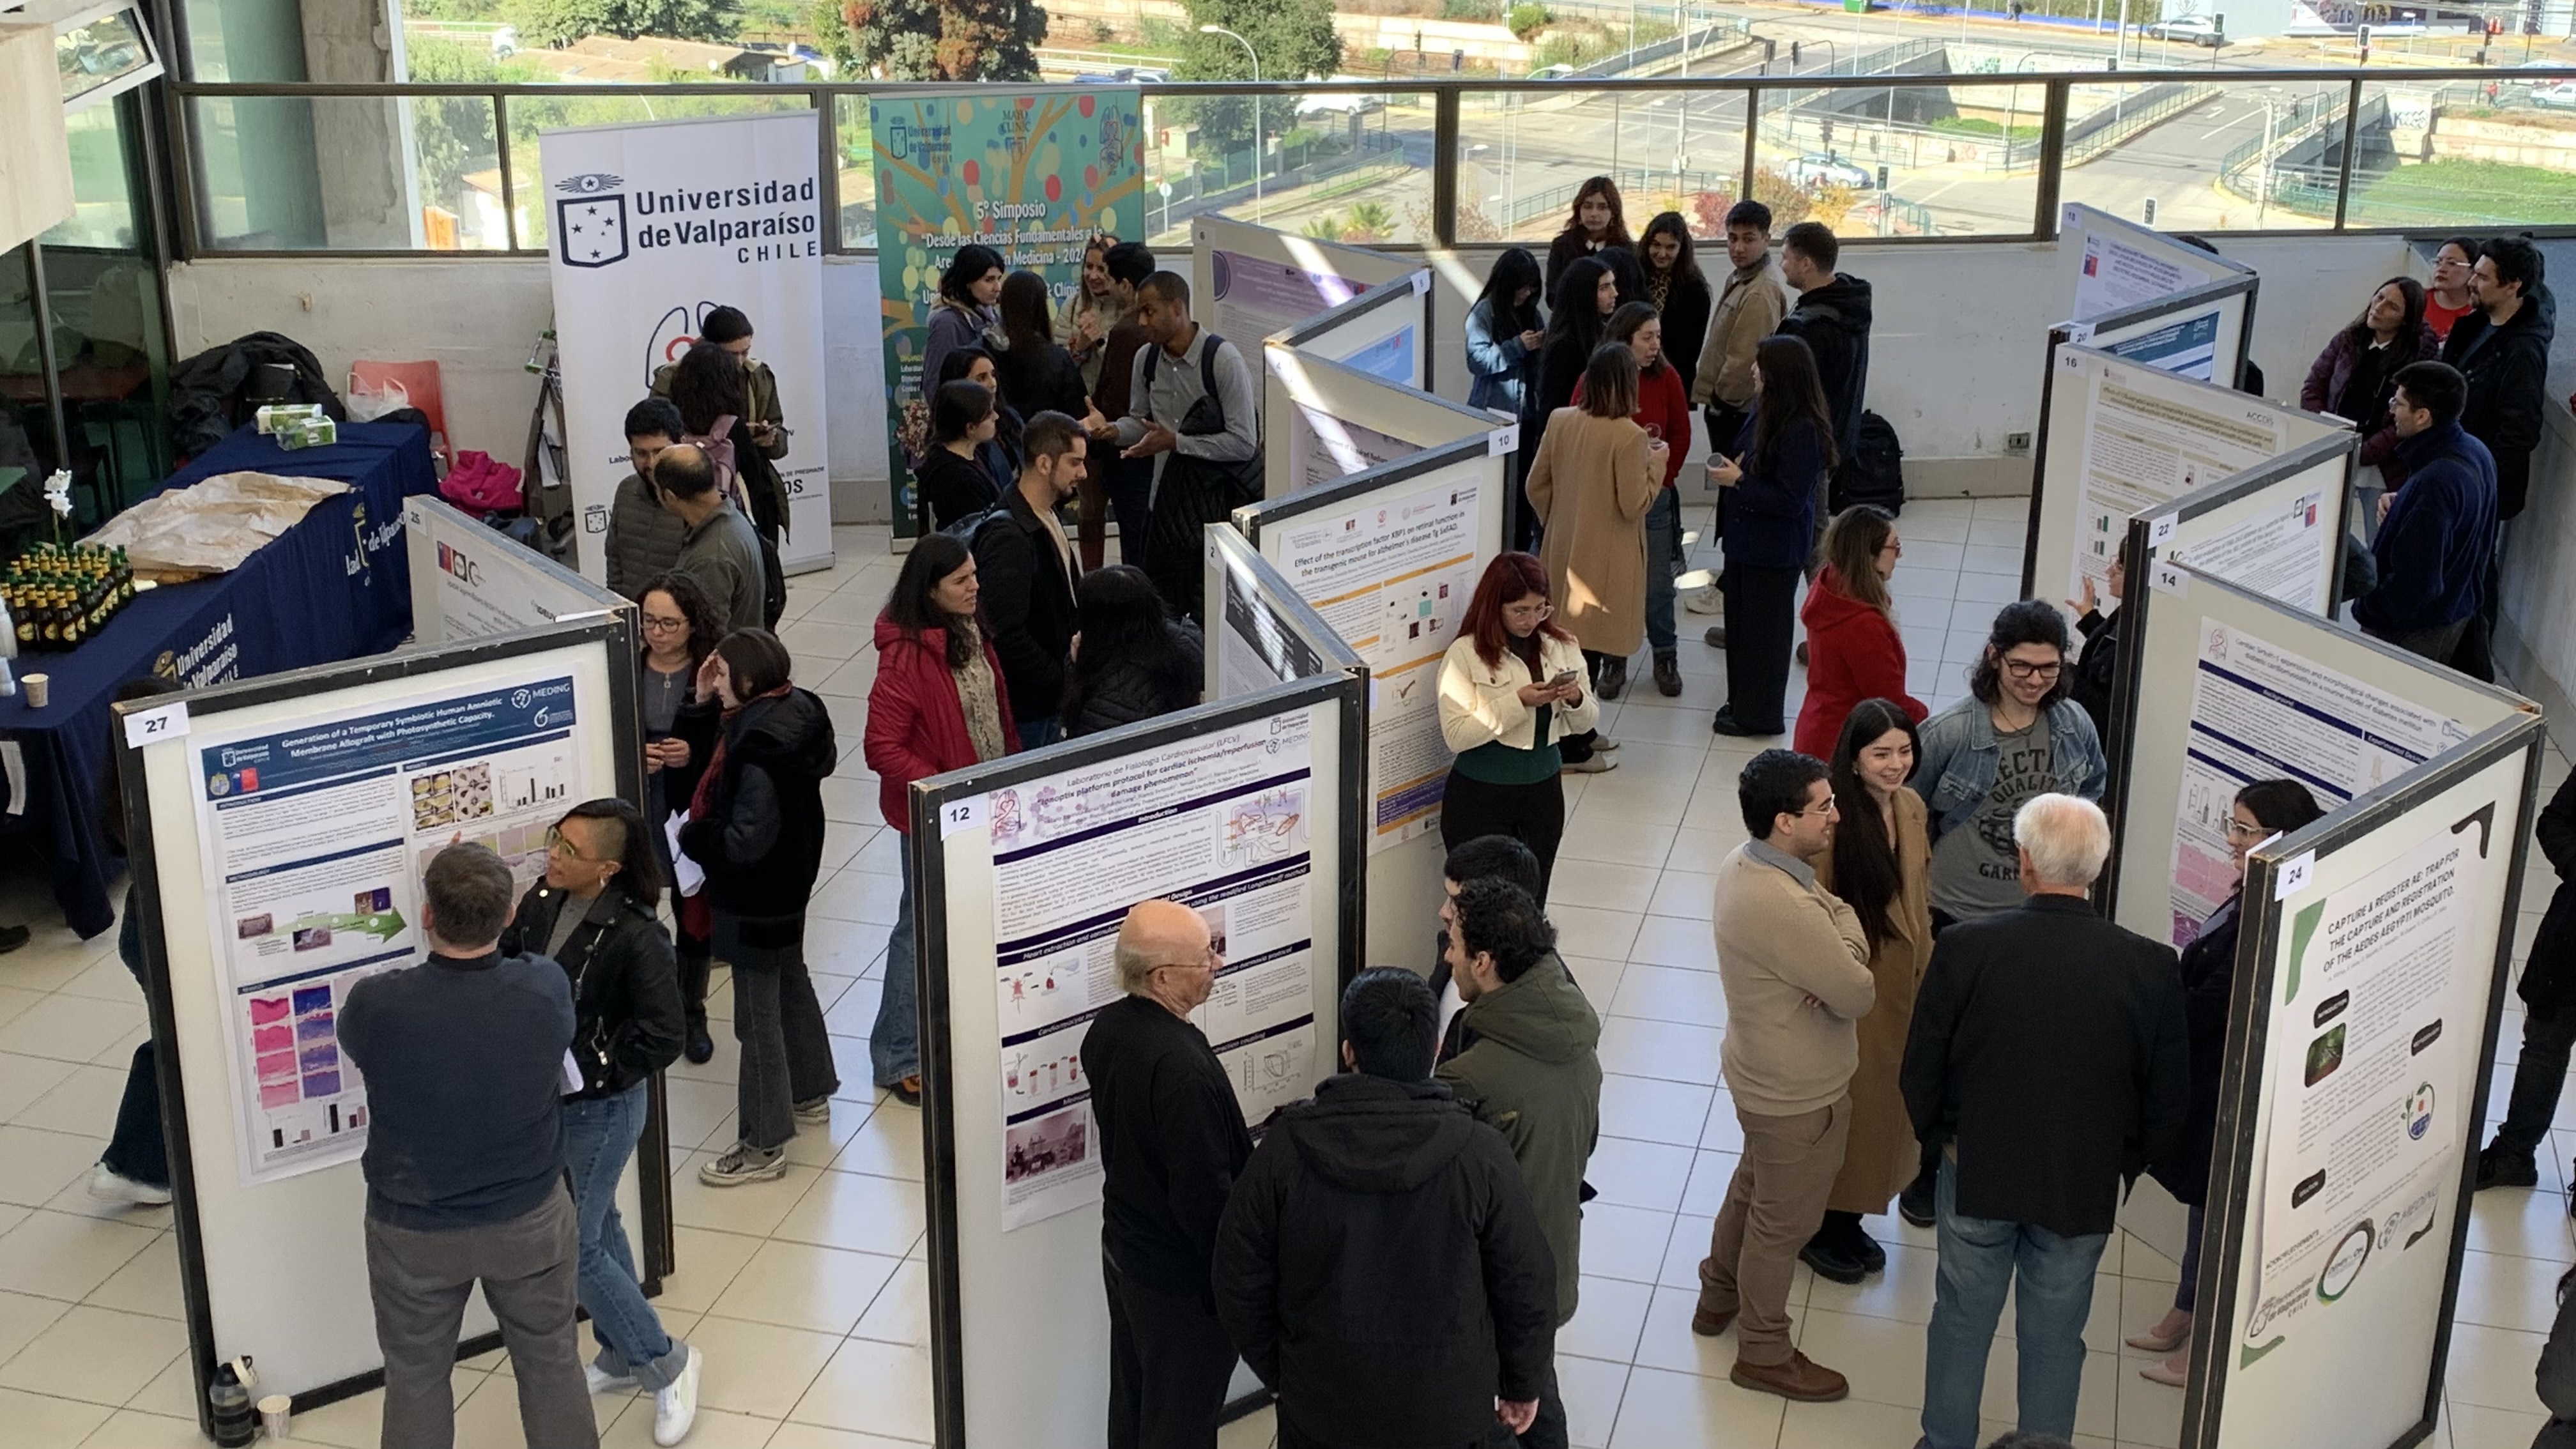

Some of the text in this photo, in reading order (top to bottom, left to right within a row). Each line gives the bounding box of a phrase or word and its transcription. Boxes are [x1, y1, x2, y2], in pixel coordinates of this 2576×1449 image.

[636, 177, 813, 215] Universidad
[992, 200, 1046, 222] Simposio
[638, 211, 815, 249] de Valparaíso
[958, 231, 971, 246] las
[974, 229, 1013, 245] Ciencias
[1015, 227, 1084, 243] Fundamentales
[1200, 232, 1205, 240] 6
[738, 241, 816, 263] CHILE
[1013, 250, 1054, 266] Medicina
[2077, 332, 2087, 343] 20
[2065, 356, 2077, 368] 16
[1498, 434, 1510, 447] 10
[411, 511, 420, 524] 25
[1294, 556, 1314, 567] Effect
[1315, 553, 1322, 563] of
[1323, 551, 1335, 561] the
[1335, 540, 1372, 558] transcription
[1373, 533, 1390, 546] factor
[1407, 526, 1414, 535] on
[1415, 519, 1434, 532] retinal
[1435, 514, 1459, 528] function
[2158, 523, 2170, 537] 22
[1301, 567, 1312, 578] the
[1314, 558, 1347, 575] transgenic
[1348, 553, 1367, 564] mouse
[1368, 549, 1376, 560] for
[1410, 531, 1432, 545] disease
[2161, 572, 2176, 588] 14
[177, 613, 233, 676] Universidad
[532, 682, 571, 699] MEDING
[144, 716, 168, 733] 27
[282, 732, 330, 748] Generation
[331, 730, 340, 739] of
[349, 720, 394, 735] Temporary
[395, 711, 434, 726] Symbiotic
[436, 705, 465, 717] Human
[467, 697, 503, 711] Amniotic
[291, 743, 337, 757] Membrane
[339, 735, 376, 748] Allograft
[376, 730, 395, 742] with
[397, 717, 456, 736] Photosynthetic
[1067, 769, 1112, 786] Laboratorio
[1114, 765, 1123, 775] de
[1162, 740, 1216, 762] Cardiovascular
[1216, 735, 1240, 748] (LFCV)
[1077, 781, 1110, 797] platform
[1112, 770, 1145, 787] protocol
[1146, 768, 1158, 778] for
[1159, 760, 1186, 774] cardiac
[1993, 774, 2057, 803] QUALIT
[1111, 784, 1142, 799] damage
[951, 807, 969, 822] 12
[1138, 807, 1177, 824] Introduction
[1209, 893, 1219, 902] the
[1220, 885, 1246, 900] modified
[1285, 867, 1307, 880] method
[2288, 865, 2303, 886] 24
[2328, 905, 2367, 935] CAPTURE
[2375, 878, 2411, 911] REGISTER
[2425, 857, 2445, 877] TRAP
[2445, 847, 2460, 866] FOR
[2330, 867, 2455, 951] THE CAPTURE AND REGISTRATION
[1023, 948, 1043, 960] Heart
[1044, 939, 1076, 954] extraction
[1077, 933, 1089, 944] and
[2324, 958, 2336, 973] OF
[2337, 947, 2352, 965] THE
[2354, 931, 2379, 956] AEDES
[2380, 910, 2412, 938] AEGYPTI
